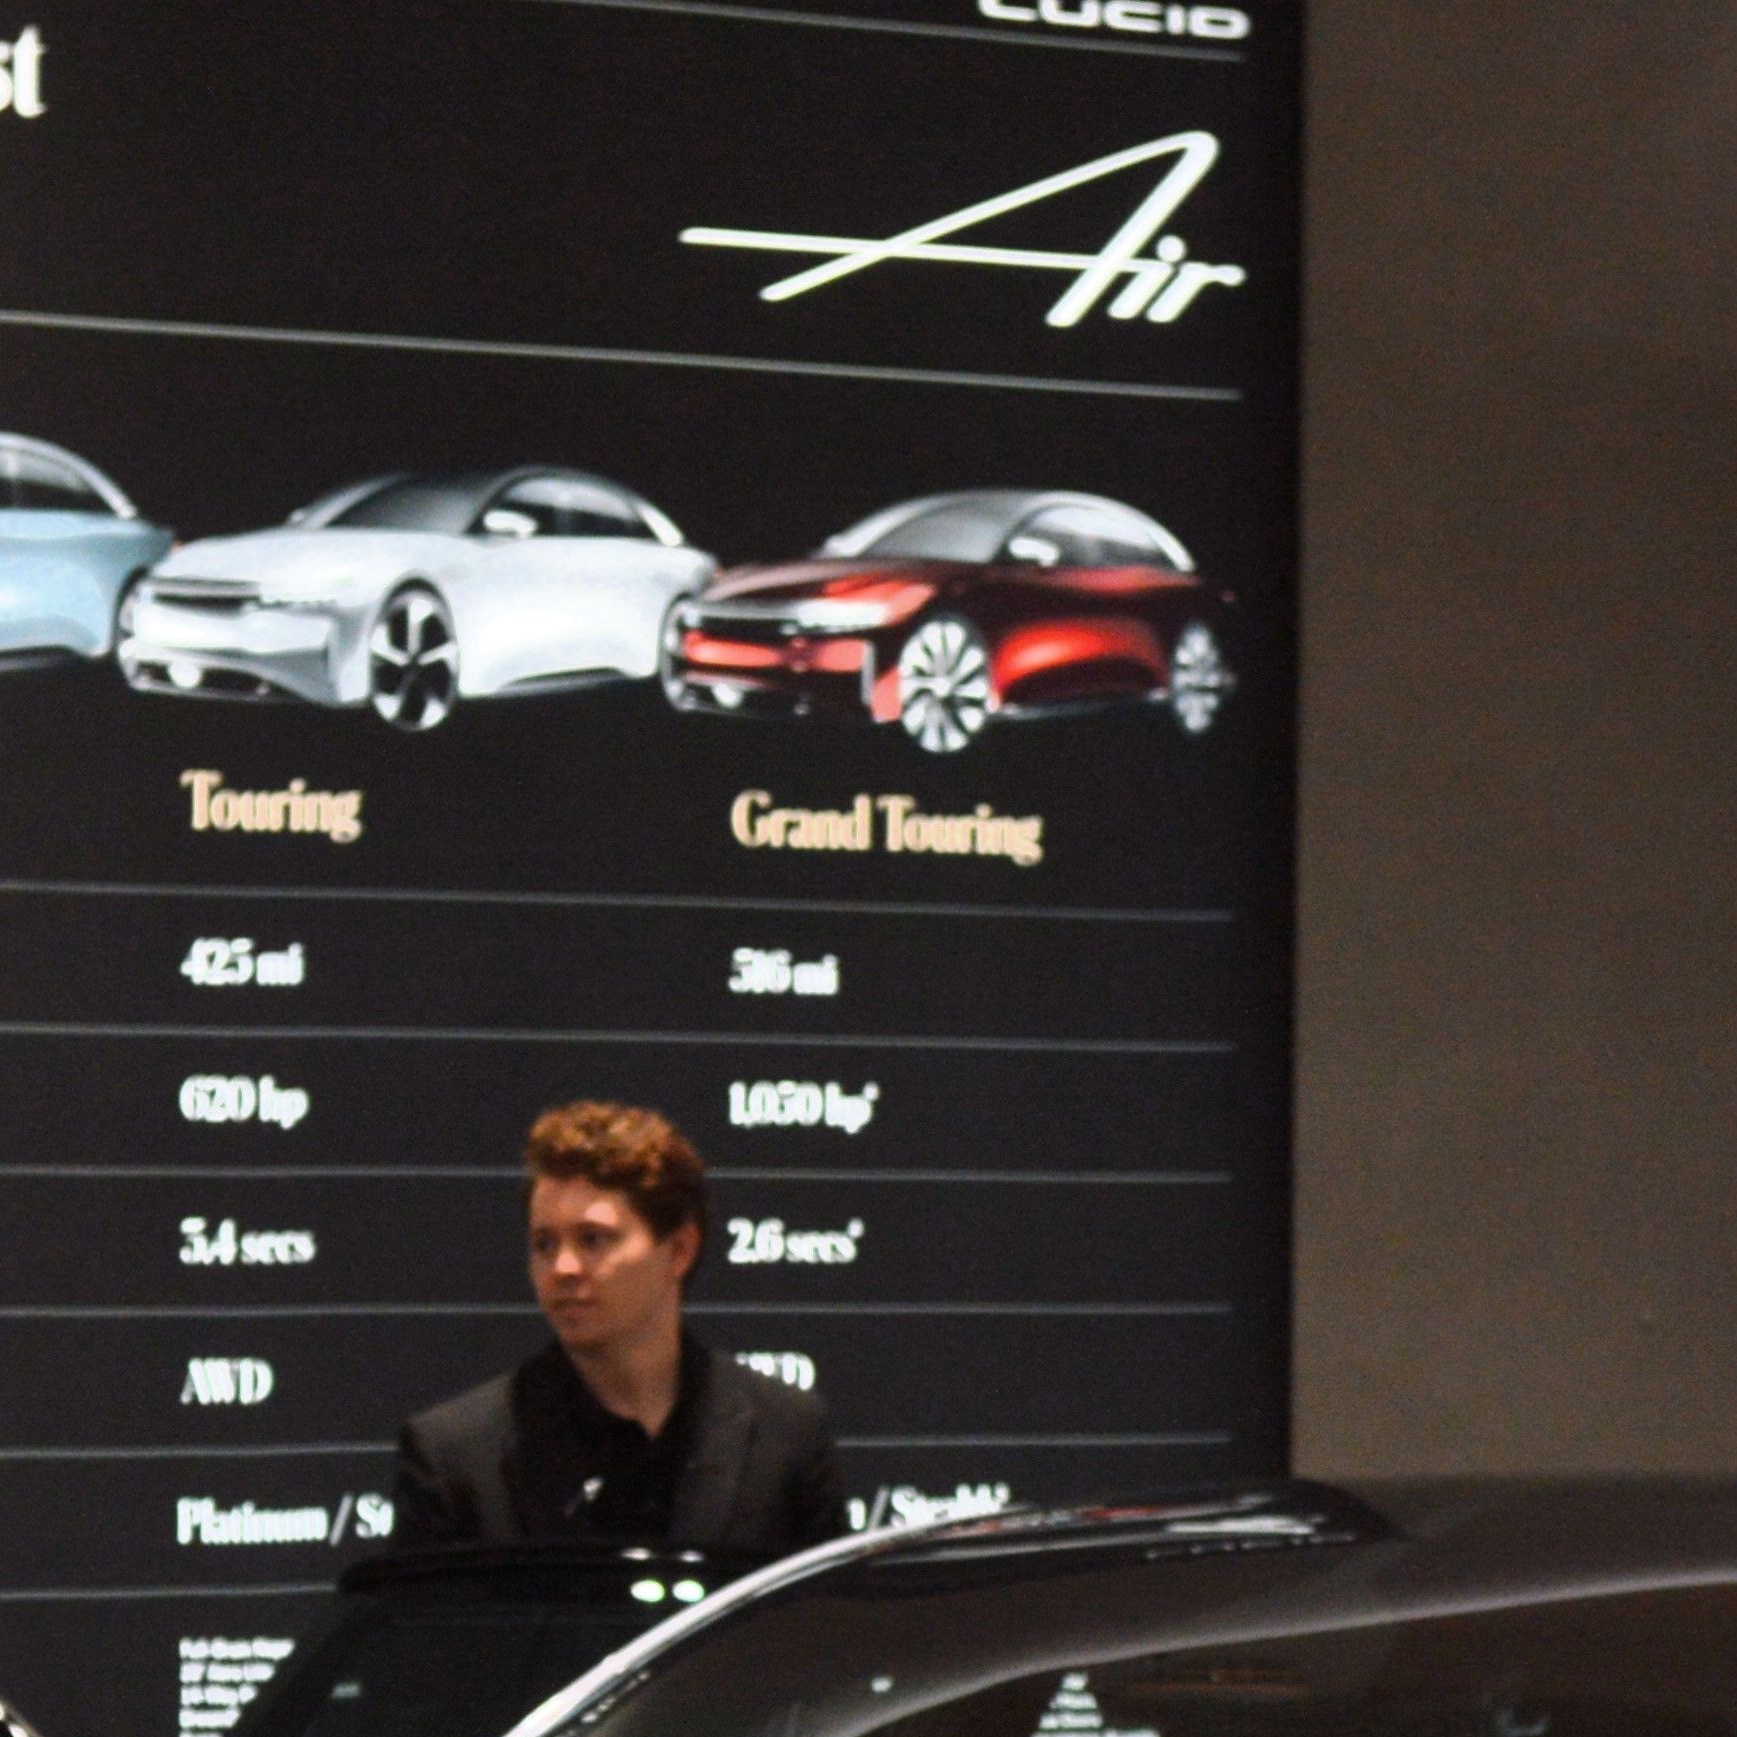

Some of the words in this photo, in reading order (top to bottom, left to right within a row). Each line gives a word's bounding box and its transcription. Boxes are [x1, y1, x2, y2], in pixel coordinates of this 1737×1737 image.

[181, 770, 361, 842] Touring
[731, 792, 871, 850] Grand
[876, 795, 1042, 865] Touring
[179, 1076, 257, 1122] 620
[257, 1076, 309, 1129] hp
[181, 1358, 273, 1405] AWD
[177, 1498, 328, 1544] Platinum
